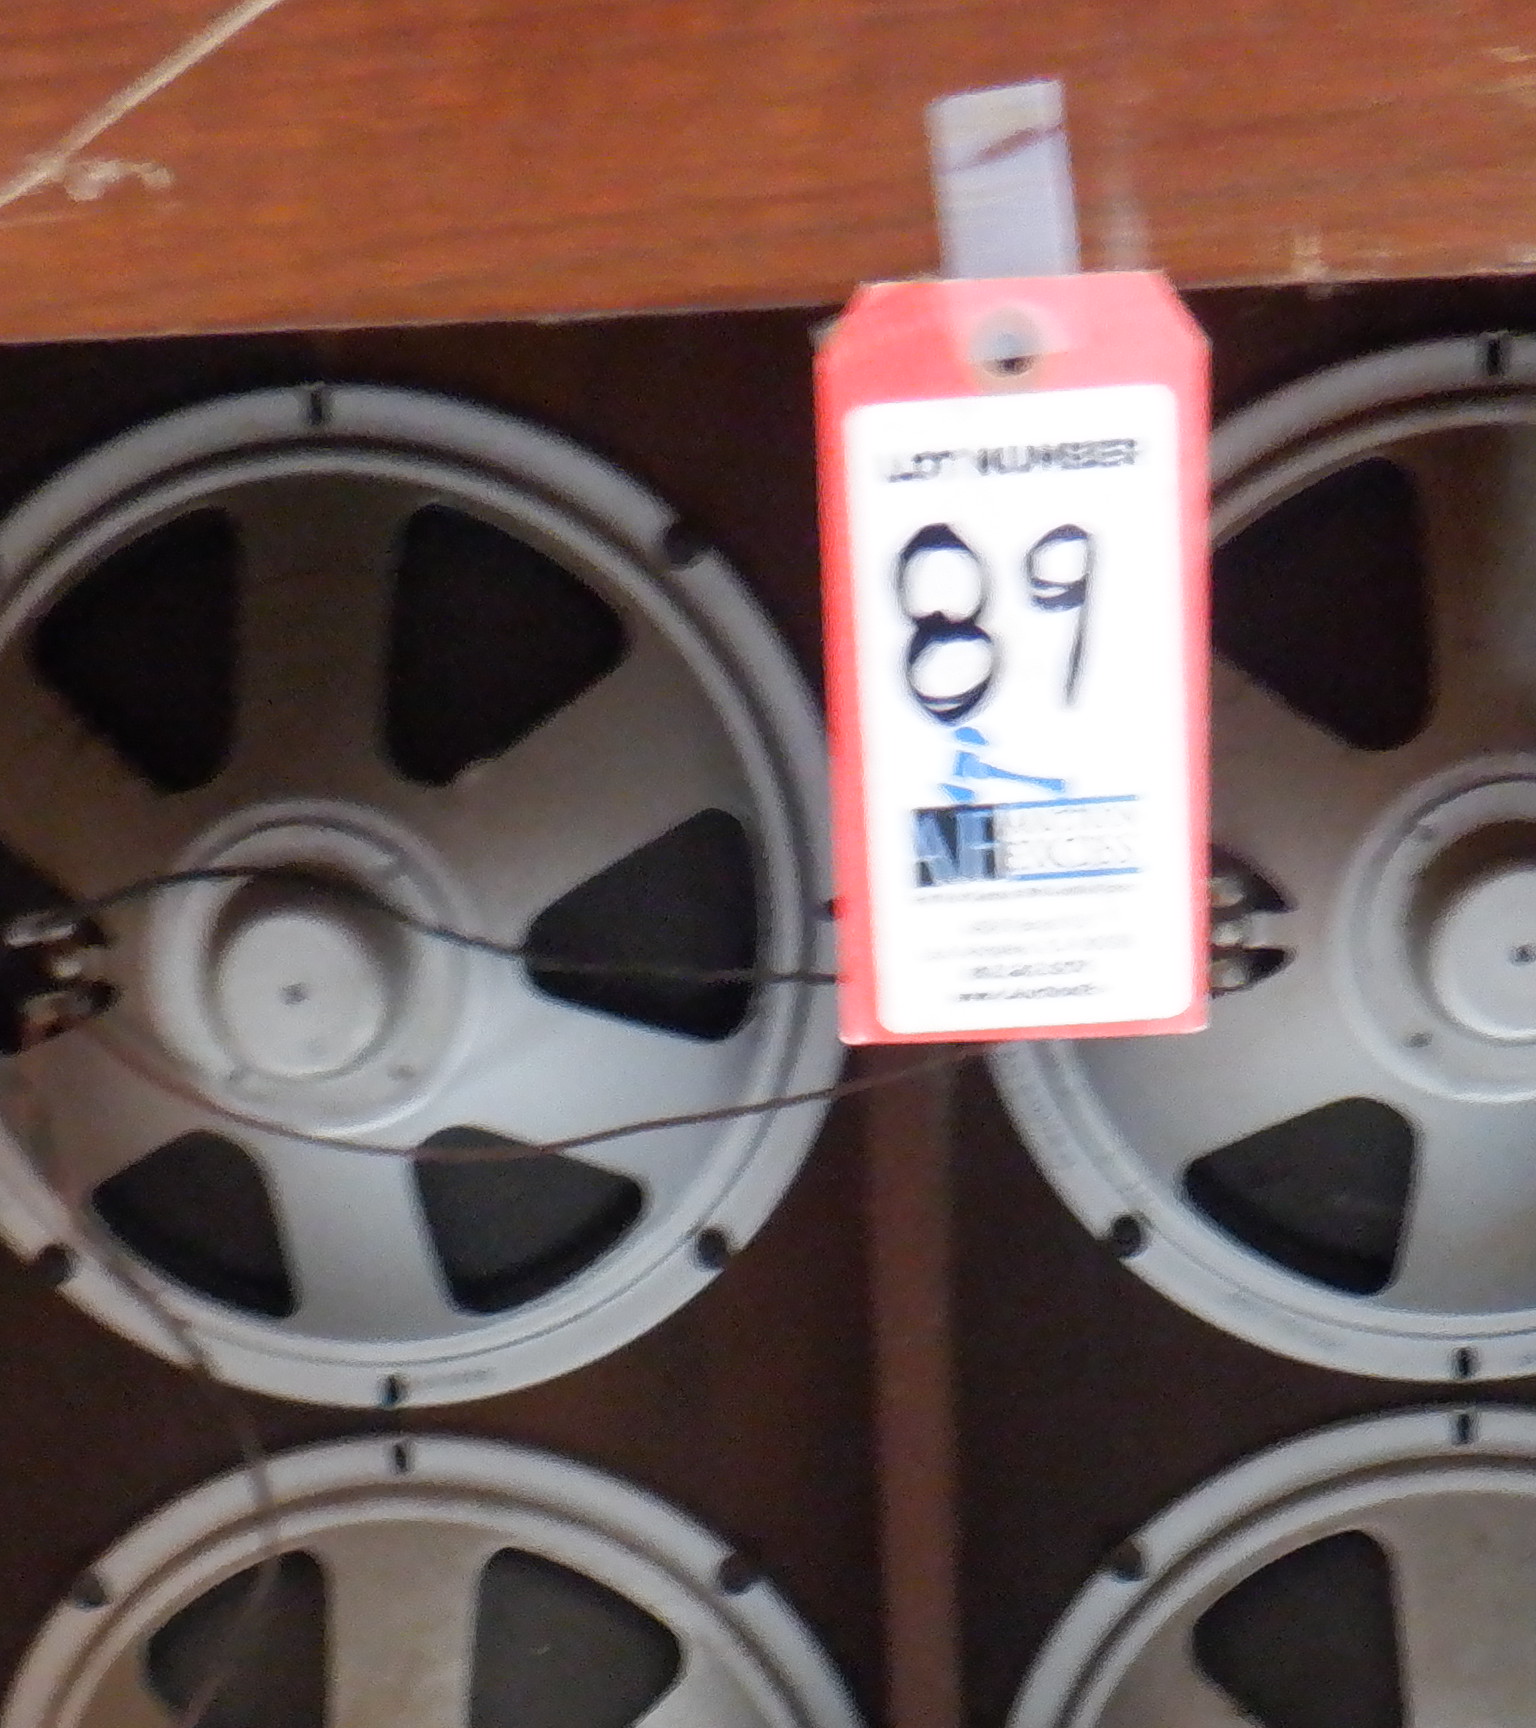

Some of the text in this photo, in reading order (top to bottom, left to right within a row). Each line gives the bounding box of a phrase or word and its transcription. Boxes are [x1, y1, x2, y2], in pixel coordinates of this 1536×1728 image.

[886, 438, 1137, 483] LOT NUMBER
[895, 522, 1096, 727] 89
